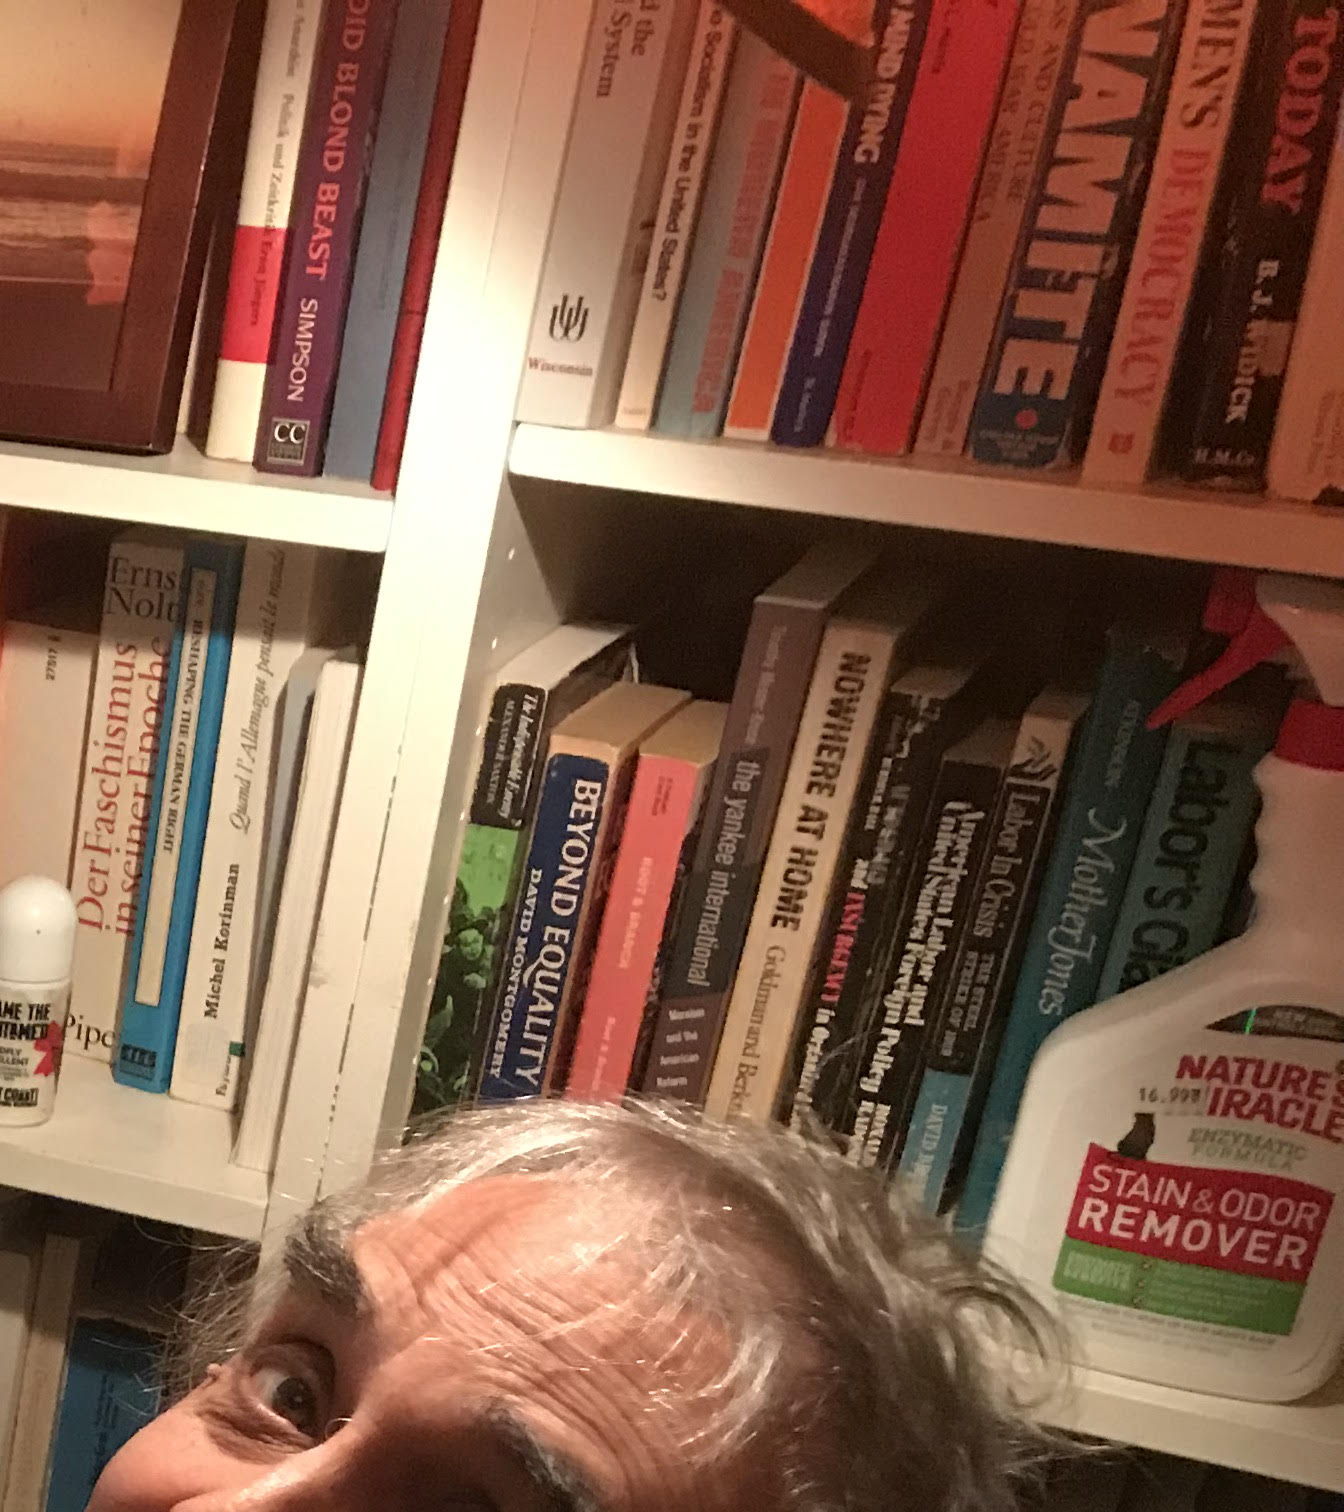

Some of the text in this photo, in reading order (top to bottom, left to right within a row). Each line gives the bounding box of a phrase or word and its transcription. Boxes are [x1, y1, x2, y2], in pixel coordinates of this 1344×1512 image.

[594, 6, 633, 100] System
[628, 15, 658, 59] the
[1260, 7, 1341, 216] TODAY
[280, 58, 362, 407] BLOND BEAST SIMPSON
[663, 173, 693, 235] United
[649, 234, 680, 304] States?
[1112, 146, 1212, 407] DEMOCRACY
[528, 357, 593, 377] Wisconsin
[181, 617, 206, 706] RESHAPING
[176, 709, 192, 740] THE
[232, 673, 276, 776] l'Allemagne
[71, 639, 146, 930] Der Faschismus
[102, 627, 177, 935] in seiner Epoche
[168, 739, 188, 806] GERMAN
[225, 775, 259, 837] Quand
[160, 806, 179, 856] RIGHT
[739, 649, 873, 1060] NOWHERE AT HOME Goldman and
[925, 797, 973, 878] United
[995, 790, 1035, 855] Labor
[1143, 738, 1240, 911] Labor's
[684, 758, 761, 989] the yankee international
[971, 874, 1016, 941] Crisis
[201, 859, 242, 1020] Michel Korinman
[503, 776, 603, 1088] BEYOND EQUALITY
[901, 805, 986, 1029] American Labor and
[1031, 803, 1131, 1024] Mother Jones
[487, 865, 543, 1080] DAVID MONTGOMERY
[27, 1002, 53, 1022] THE
[859, 1022, 902, 1096] Policy
[920, 1103, 949, 1150] DAVID
[1188, 1127, 1307, 1162] ENZYMATIC
[1207, 1086, 1344, 1145] IRACLE
[1191, 1143, 1294, 1172] FORMULA
[1077, 1197, 1310, 1271] REMOVER
[1087, 1164, 1323, 1232] STAIN & ODOR
